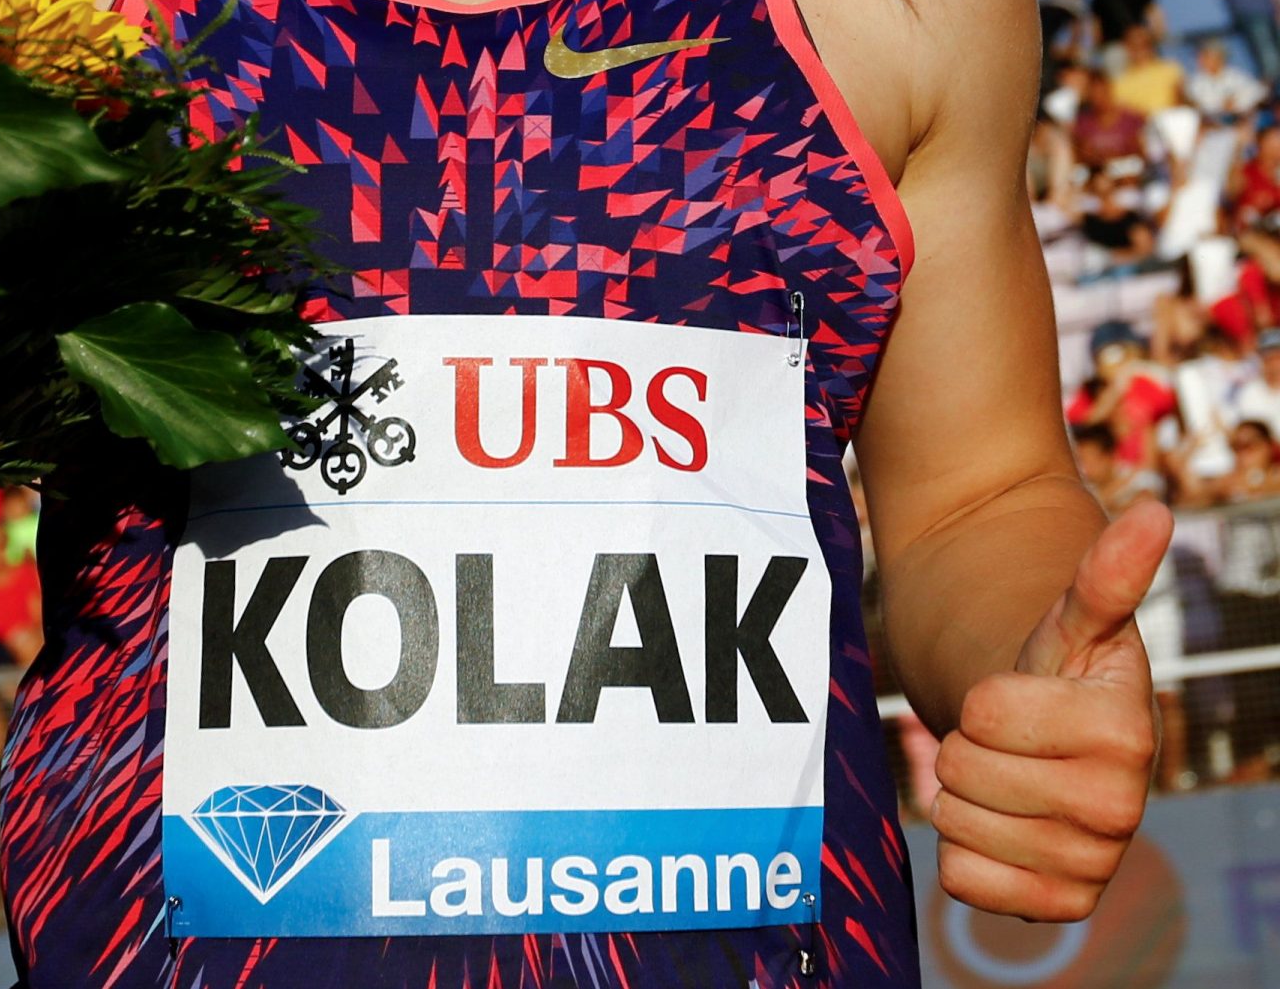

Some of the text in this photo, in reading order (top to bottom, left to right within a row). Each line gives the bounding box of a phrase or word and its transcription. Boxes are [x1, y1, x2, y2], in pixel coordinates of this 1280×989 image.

[443, 357, 709, 473] UBS
[199, 549, 810, 730] KOLAK
[370, 838, 802, 918] Lausanne
